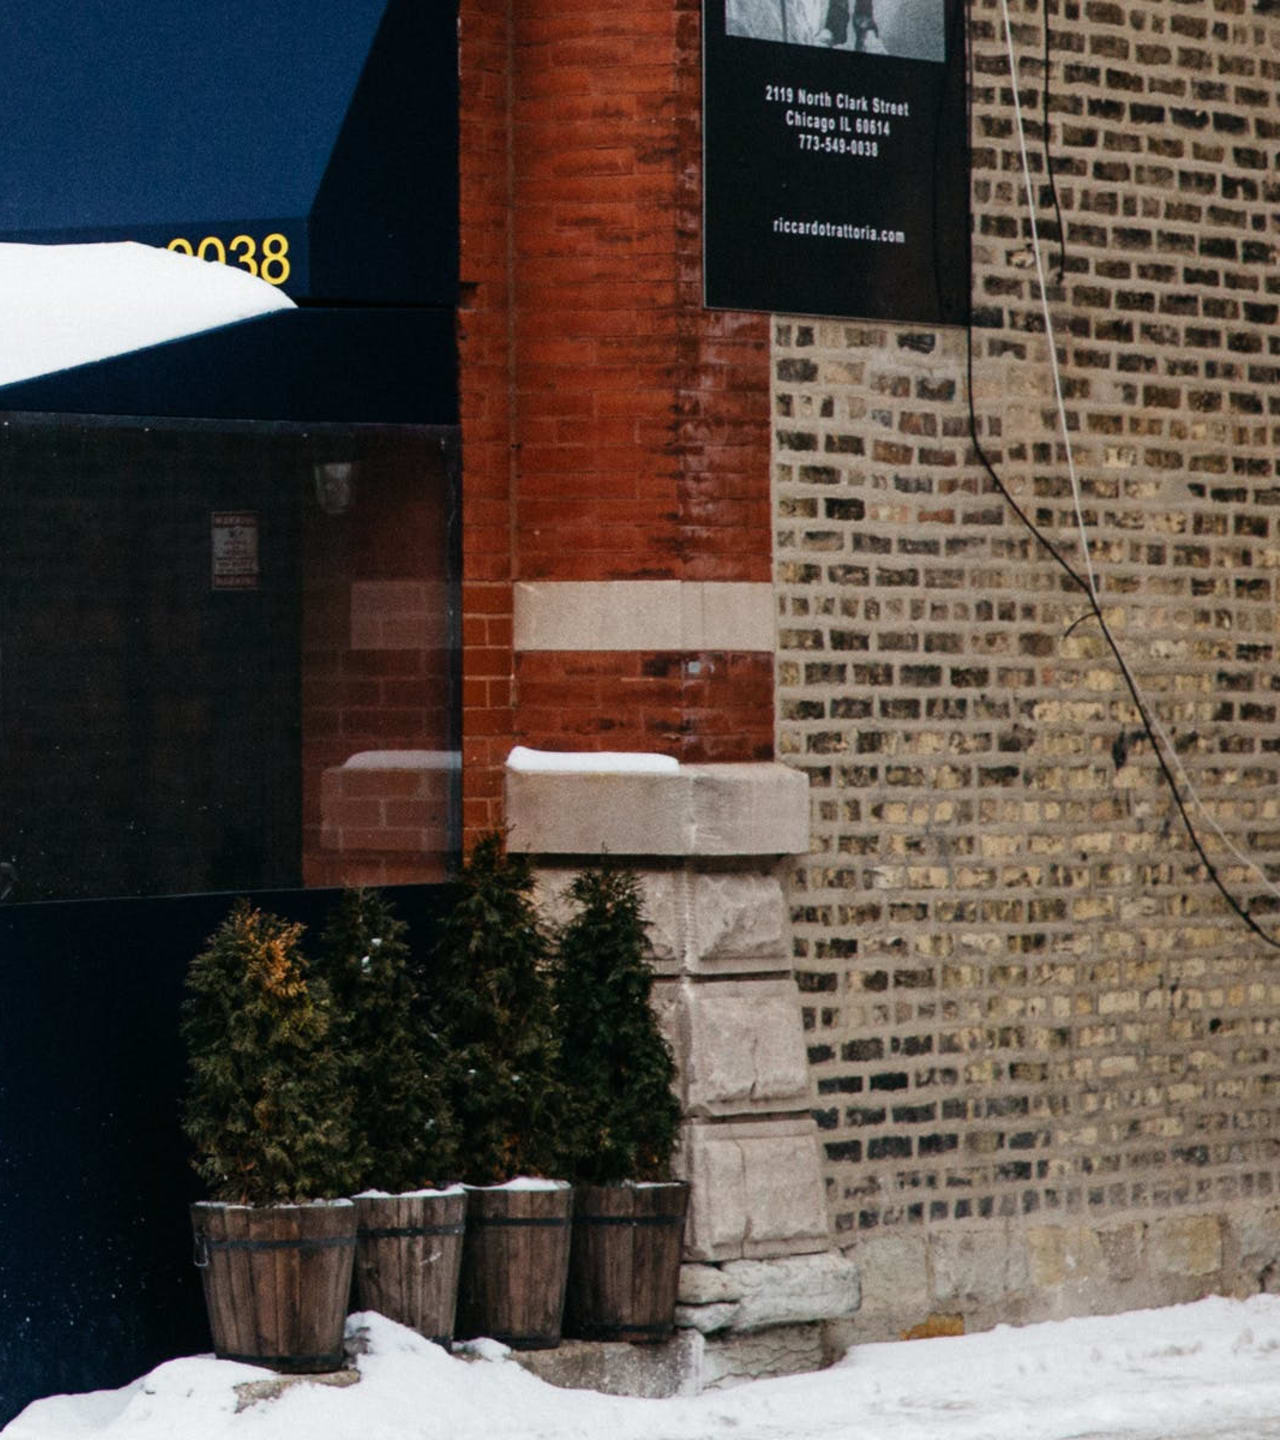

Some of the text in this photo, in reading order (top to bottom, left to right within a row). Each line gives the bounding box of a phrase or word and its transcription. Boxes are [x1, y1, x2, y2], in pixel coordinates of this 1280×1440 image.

[765, 85, 909, 117] 2119 North Clark Street
[785, 110, 890, 136] Chicago IL 60614
[799, 134, 878, 157] 773-549-0038
[773, 216, 905, 243] riccardotrattoria.com
